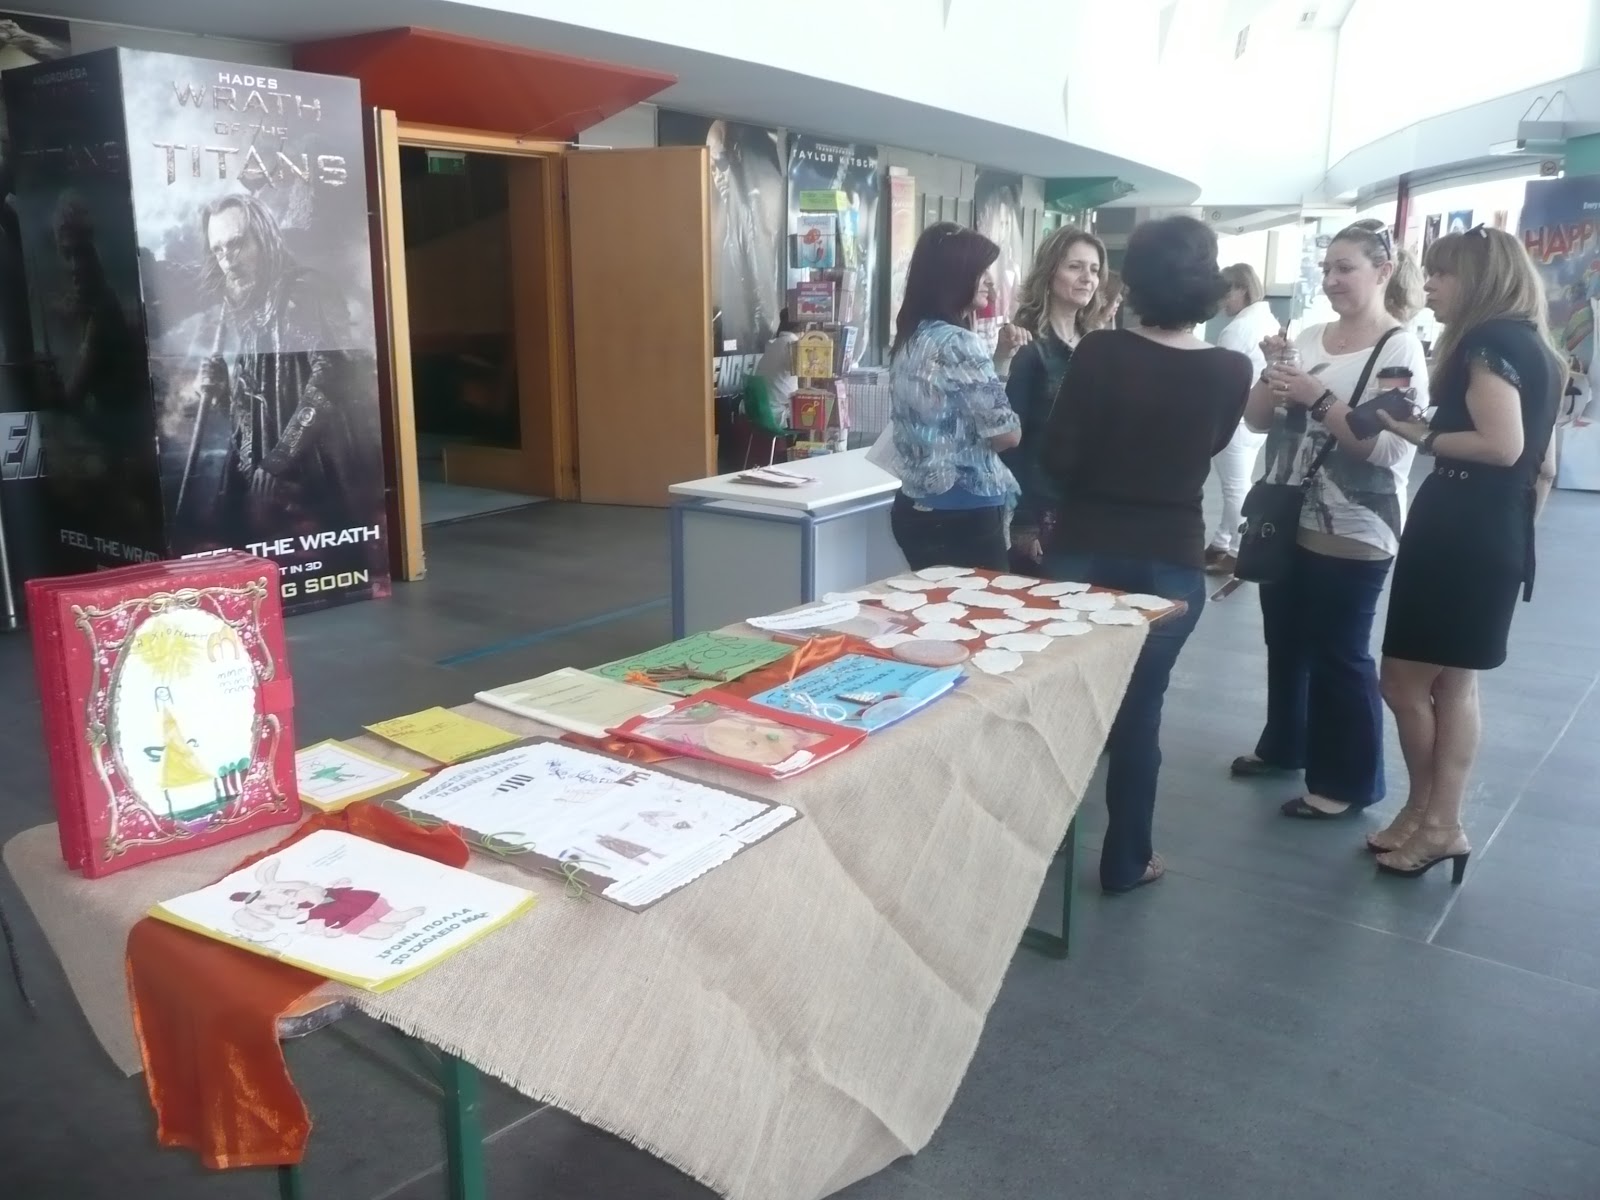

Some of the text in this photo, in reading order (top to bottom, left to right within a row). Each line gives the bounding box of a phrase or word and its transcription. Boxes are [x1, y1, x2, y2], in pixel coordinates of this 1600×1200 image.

[218, 72, 278, 90] HADES
[173, 80, 321, 122] WRATH
[214, 120, 289, 140] OF THE
[152, 140, 348, 189] TITANS
[792, 149, 877, 169] TAYLOR KITSCH
[1524, 222, 1600, 264] HAPP
[60, 528, 93, 550] FEEL
[94, 537, 120, 558] THE
[245, 537, 295, 558] THE
[299, 524, 380, 551] WRATH
[290, 564, 303, 574] IN
[305, 561, 323, 572] 3D
[305, 569, 369, 594] SOON
[376, 908, 472, 959] ΧΡΟΝΙΑ ΠΟΛΛΑ
[408, 923, 460, 953] ΣΧΟΛΕΙΟ
[461, 912, 489, 924] ΜΑΣ
